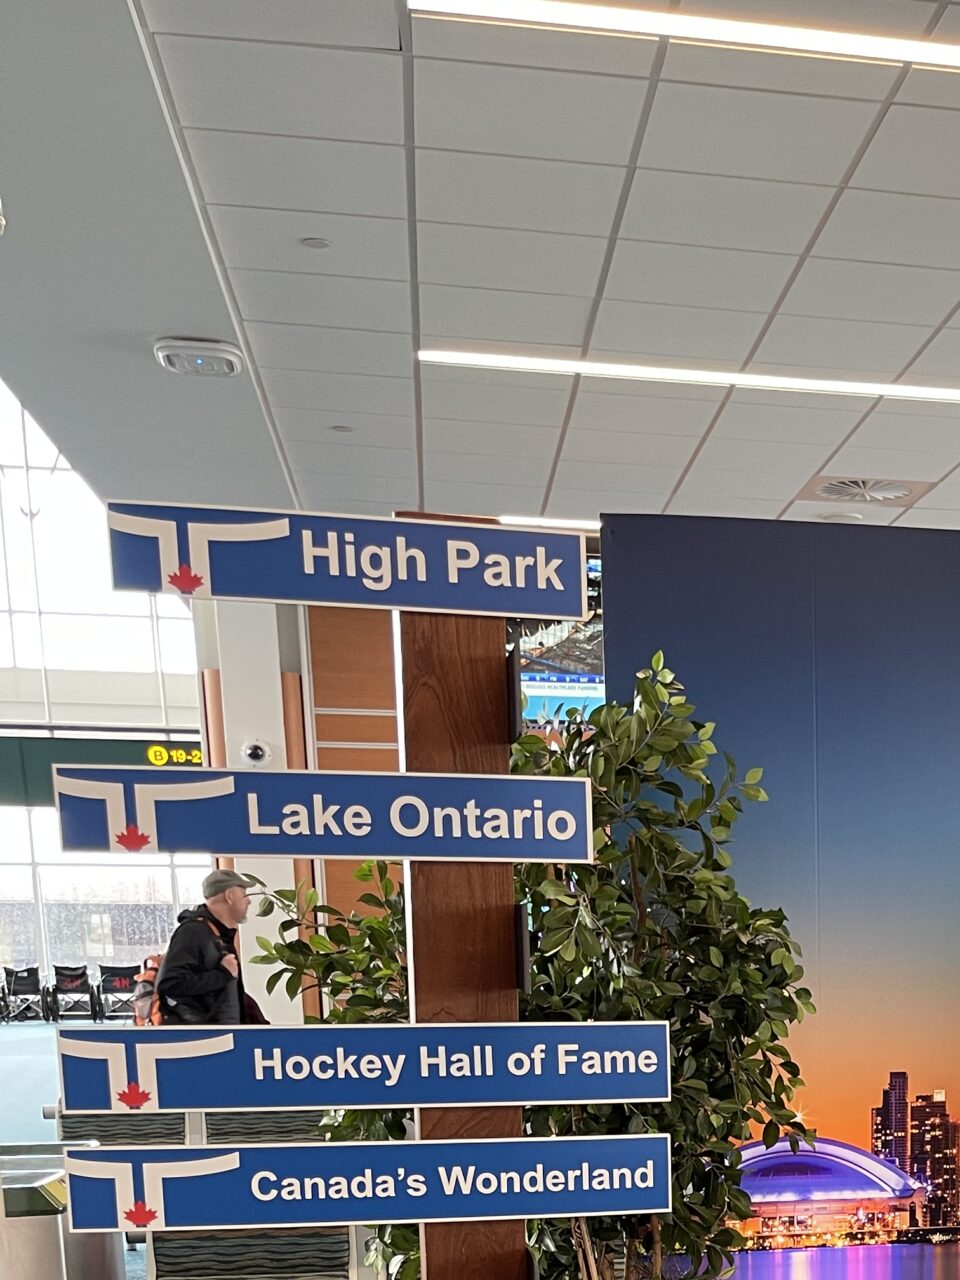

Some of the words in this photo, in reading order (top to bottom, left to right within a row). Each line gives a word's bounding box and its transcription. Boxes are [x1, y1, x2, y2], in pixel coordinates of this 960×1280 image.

[302, 530, 426, 590] High
[447, 540, 565, 591] Park
[170, 749, 203, 764] 19-2
[248, 793, 372, 837] Lake
[390, 795, 577, 841] Ontario
[254, 1046, 406, 1087] Hockey
[420, 1045, 494, 1078] Hall
[507, 1043, 546, 1076] of
[558, 1043, 658, 1075] Fame
[251, 1168, 428, 1202] Canada's
[438, 1160, 654, 1196] Wonderland
